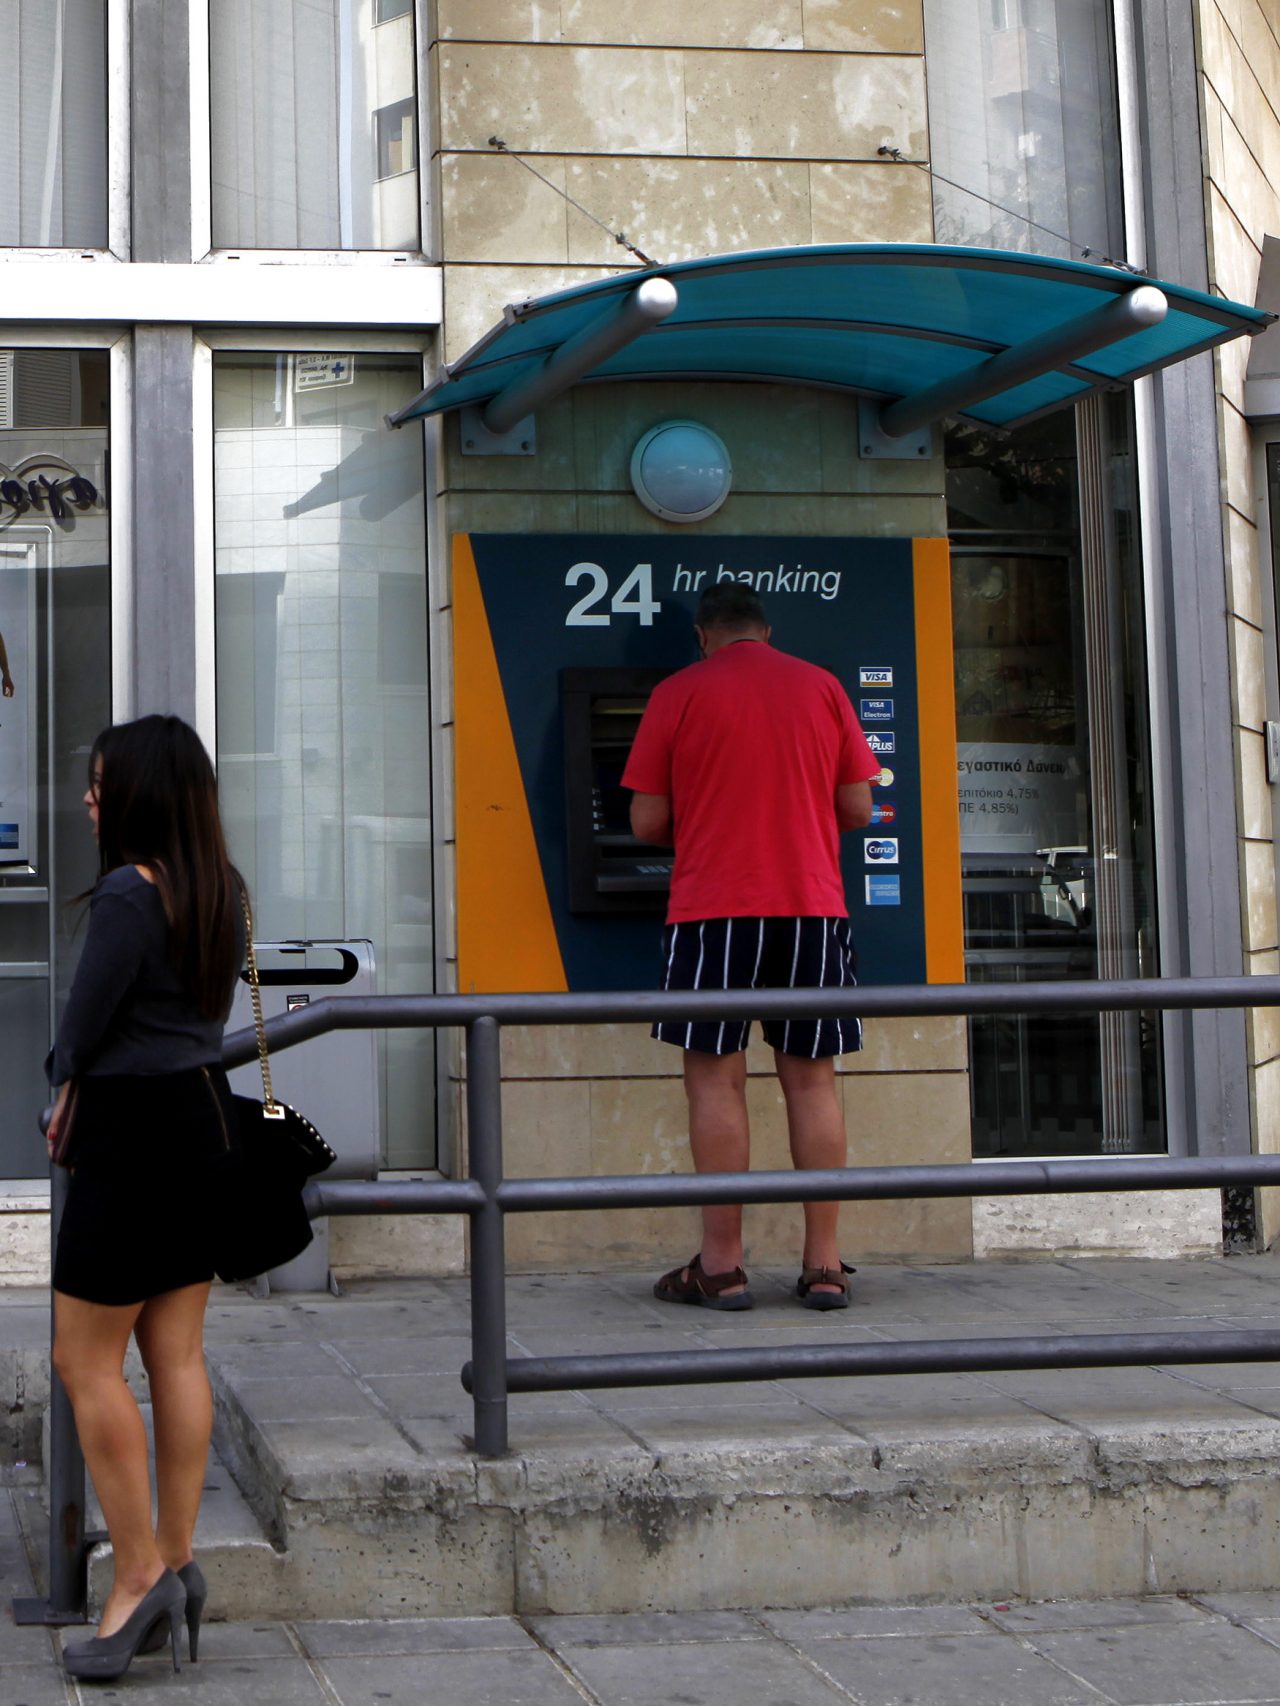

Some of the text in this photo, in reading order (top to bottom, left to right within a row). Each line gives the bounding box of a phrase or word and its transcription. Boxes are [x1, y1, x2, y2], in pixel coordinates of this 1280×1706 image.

[565, 562, 841, 626] 24 hr banking
[865, 673, 888, 681] VISA
[871, 742, 893, 751] PLUS
[957, 759, 1021, 774] εγαστικό
[869, 845, 895, 854] Cirrus
